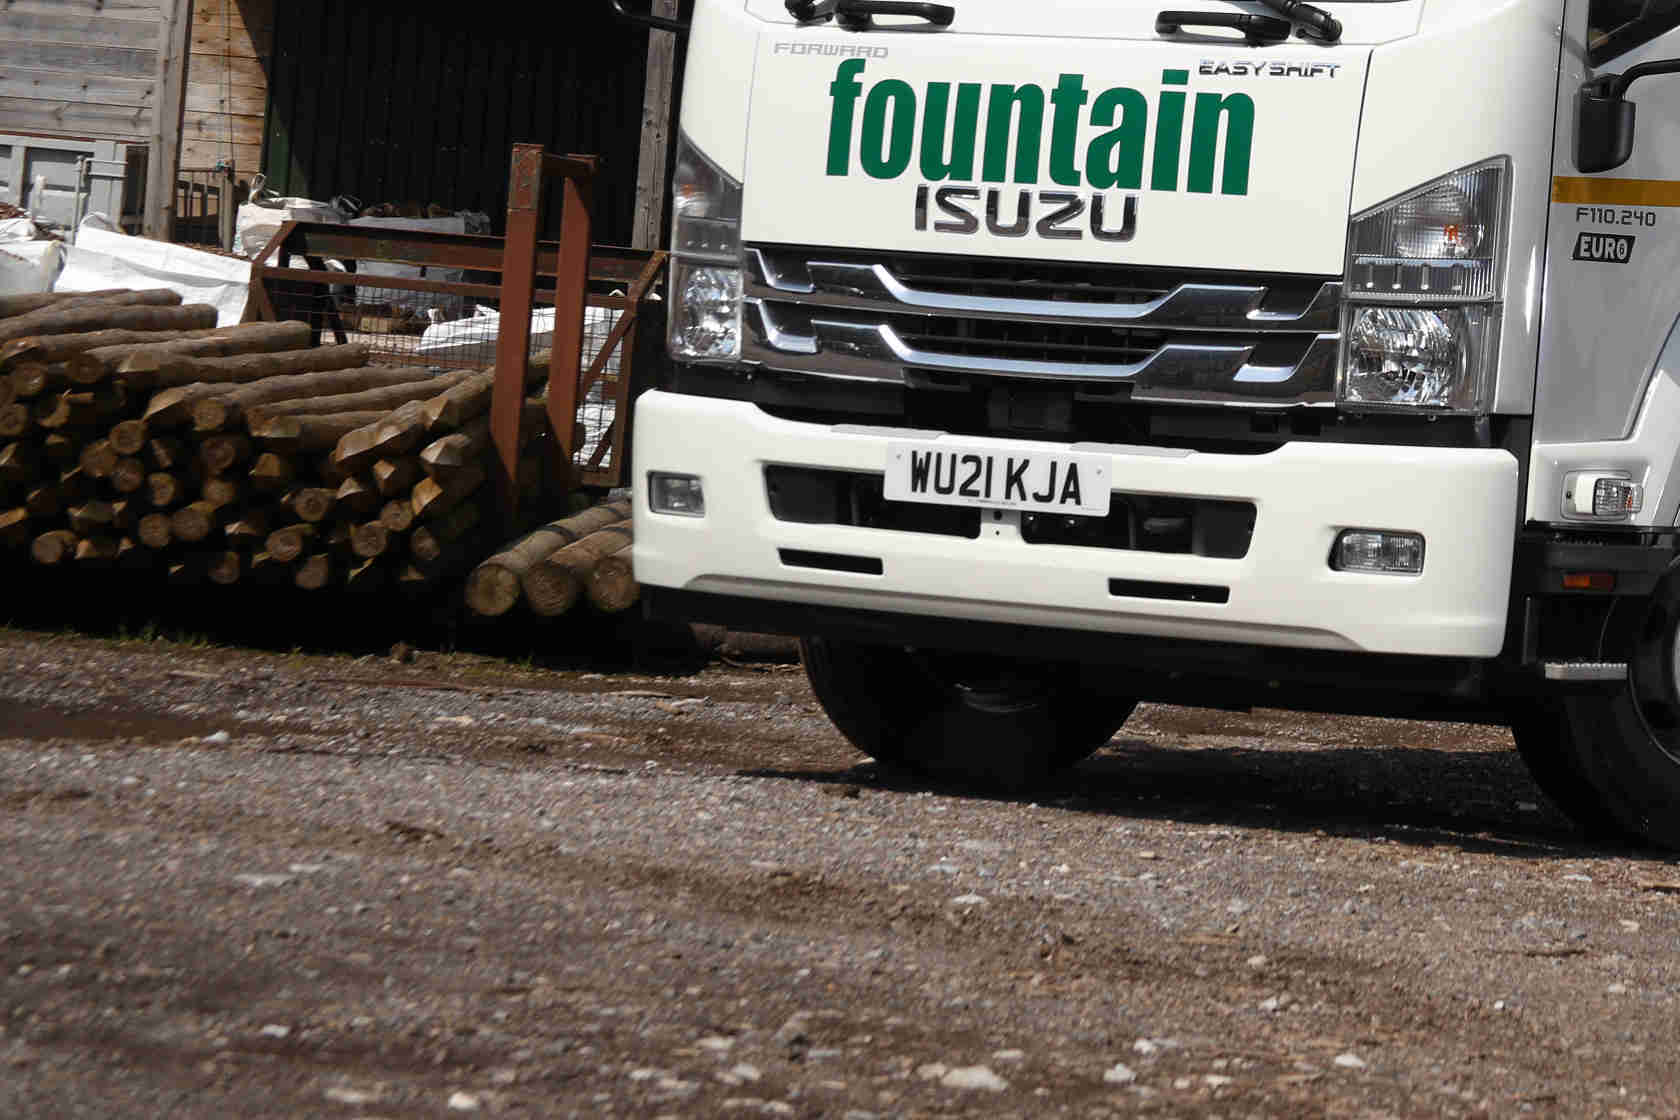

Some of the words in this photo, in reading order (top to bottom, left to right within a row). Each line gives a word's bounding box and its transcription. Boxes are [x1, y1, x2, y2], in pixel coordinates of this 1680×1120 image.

[774, 42, 889, 59] FORWARD
[826, 58, 1255, 196] fountain
[914, 183, 1138, 242] ISUZU
[1576, 207, 1657, 227] F110.240
[911, 450, 993, 498] WU21
[1004, 457, 1082, 506] KJA
